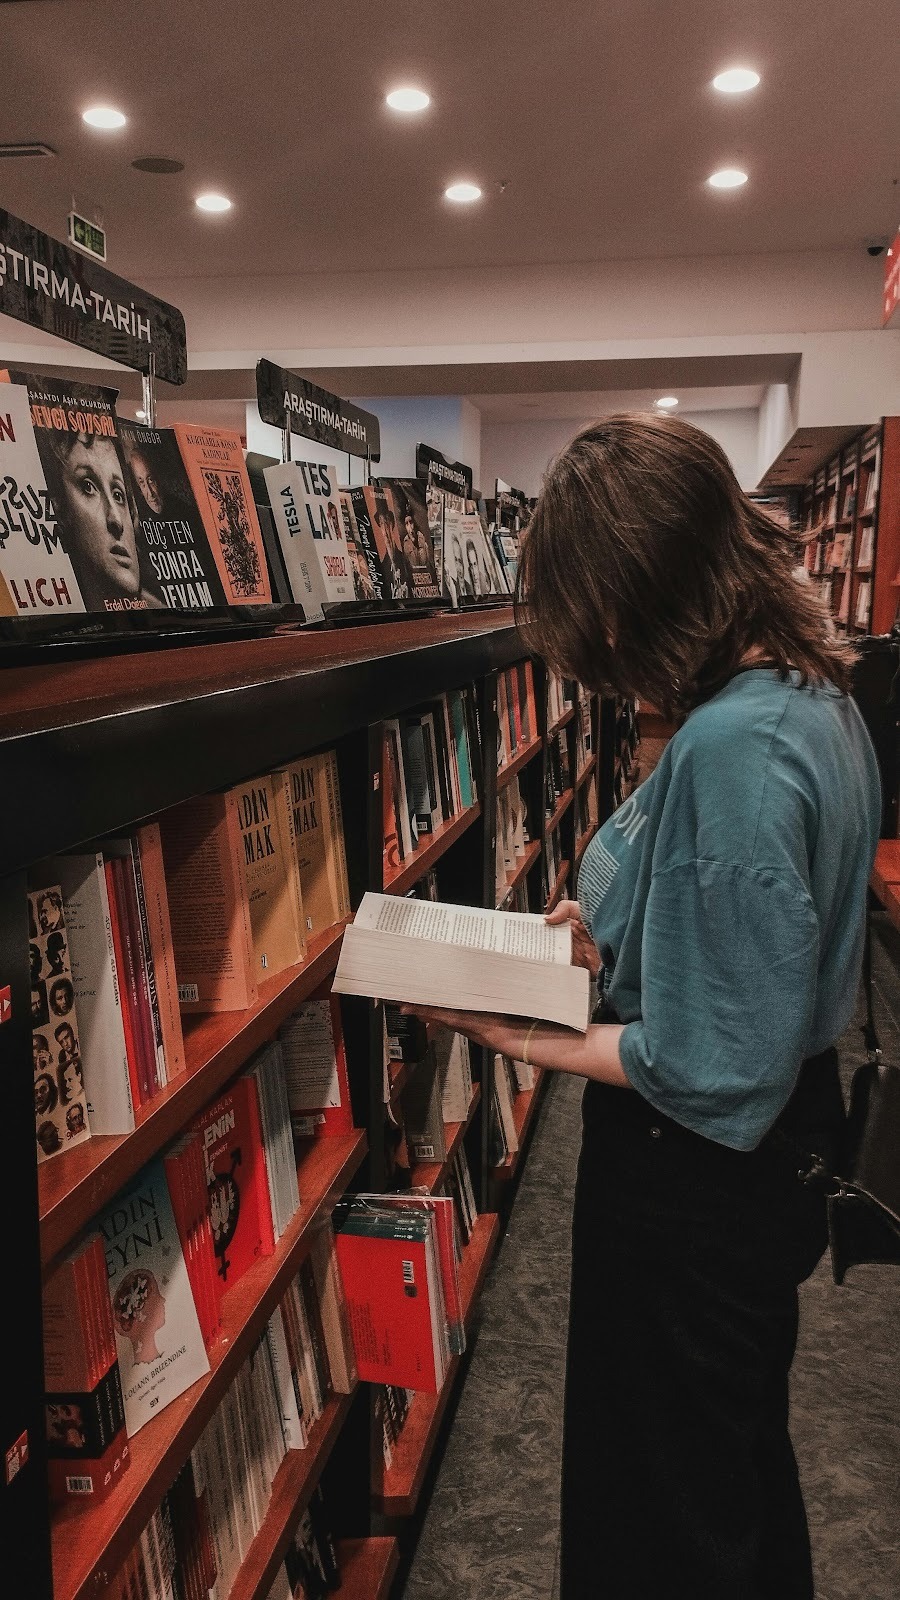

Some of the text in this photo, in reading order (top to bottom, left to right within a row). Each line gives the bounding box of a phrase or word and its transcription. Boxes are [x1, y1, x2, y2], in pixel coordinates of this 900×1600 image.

[283, 390, 367, 442] ARAŞTIRMA-TARİH
[295, 460, 332, 497] TES
[280, 485, 301, 538] TESLA
[148, 549, 206, 581] SONRA
[9, 578, 72, 609] LICH
[243, 824, 276, 866] MAK
